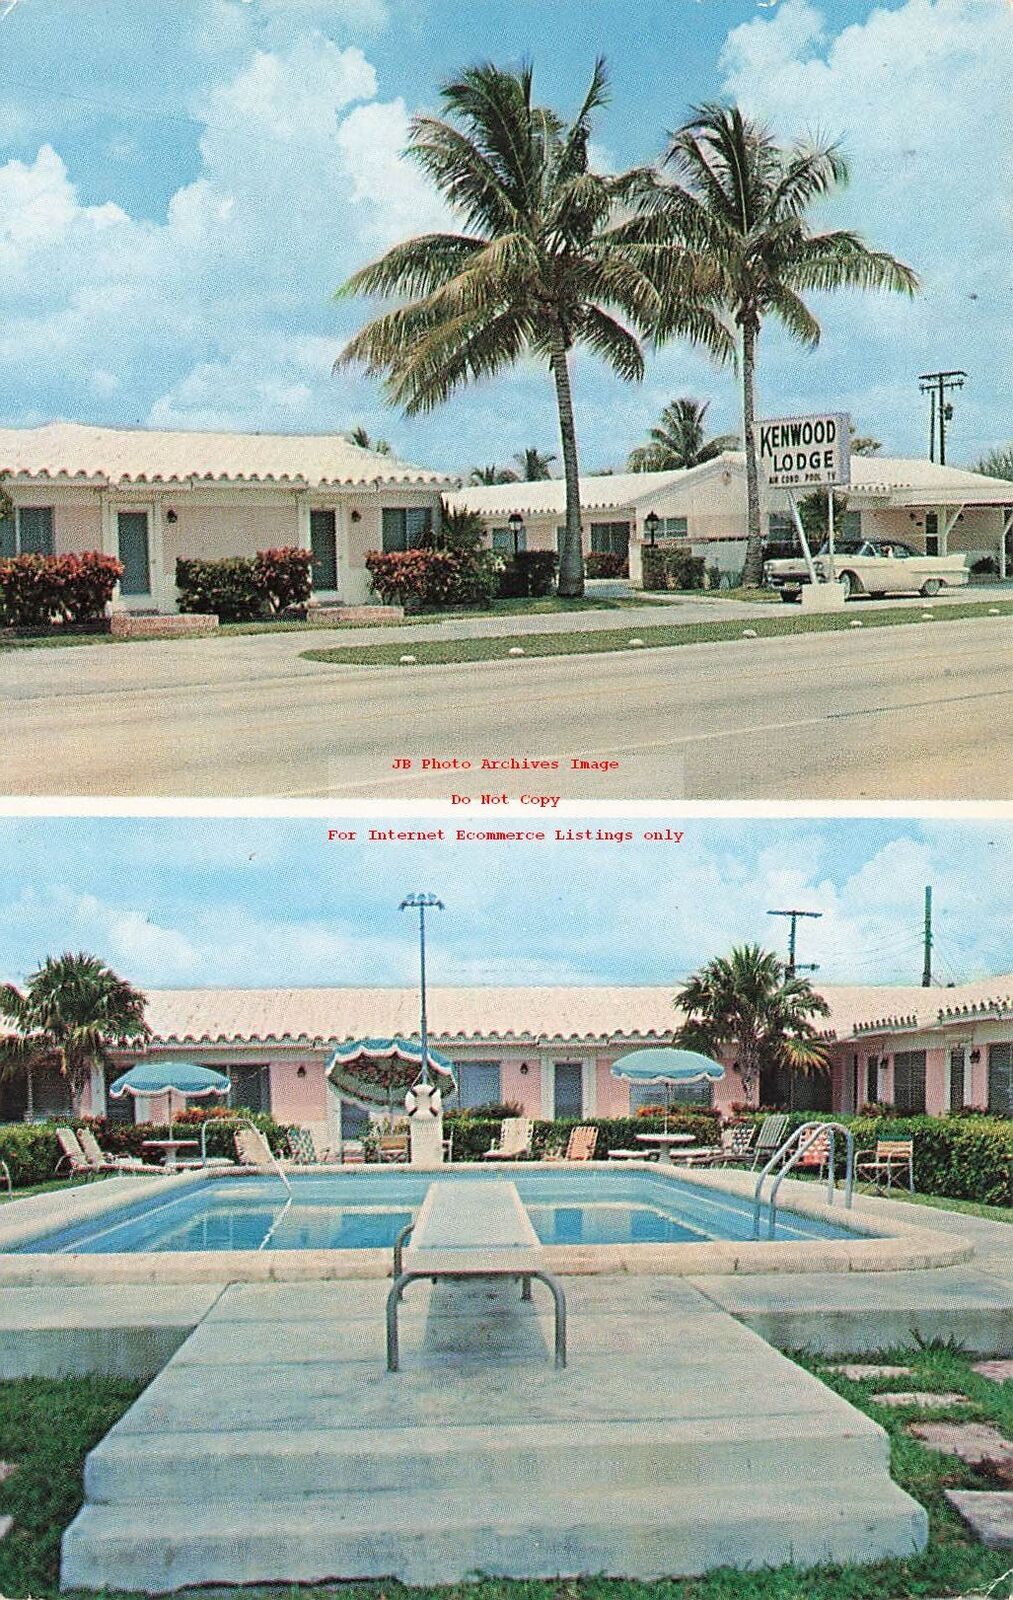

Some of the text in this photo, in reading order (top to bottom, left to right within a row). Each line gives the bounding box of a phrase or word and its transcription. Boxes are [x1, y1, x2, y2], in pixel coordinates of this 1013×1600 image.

[760, 420, 836, 458] KENWOOD
[774, 450, 834, 472] LODGE
[805, 472, 821, 482] POOL
